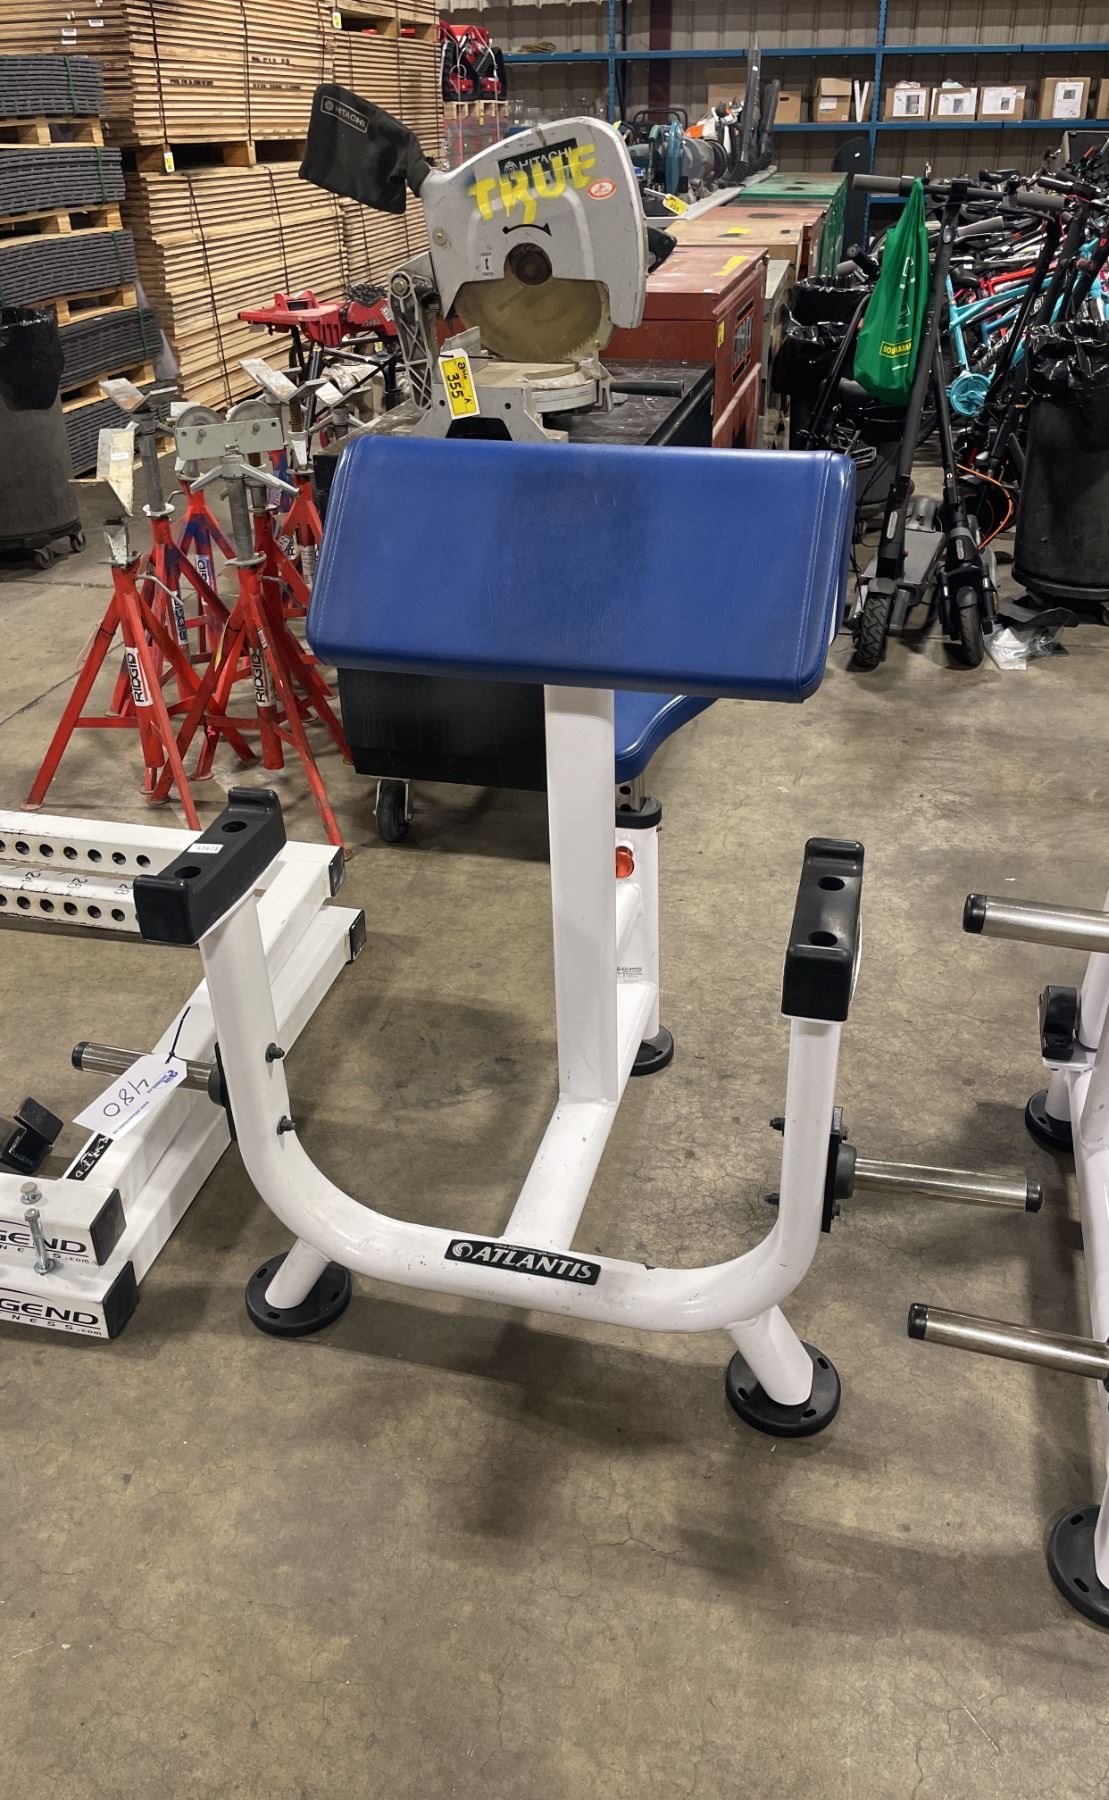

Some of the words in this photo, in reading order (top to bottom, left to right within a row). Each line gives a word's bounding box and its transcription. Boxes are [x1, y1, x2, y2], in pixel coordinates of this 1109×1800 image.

[335, 105, 366, 127] HITACHI
[468, 144, 596, 225] TRUE
[447, 373, 464, 399] 355
[127, 652, 144, 702] RIDGID
[251, 653, 266, 703] RIDGID
[103, 1078, 150, 1117] 480
[472, 1246, 592, 1279] ATLANTIS
